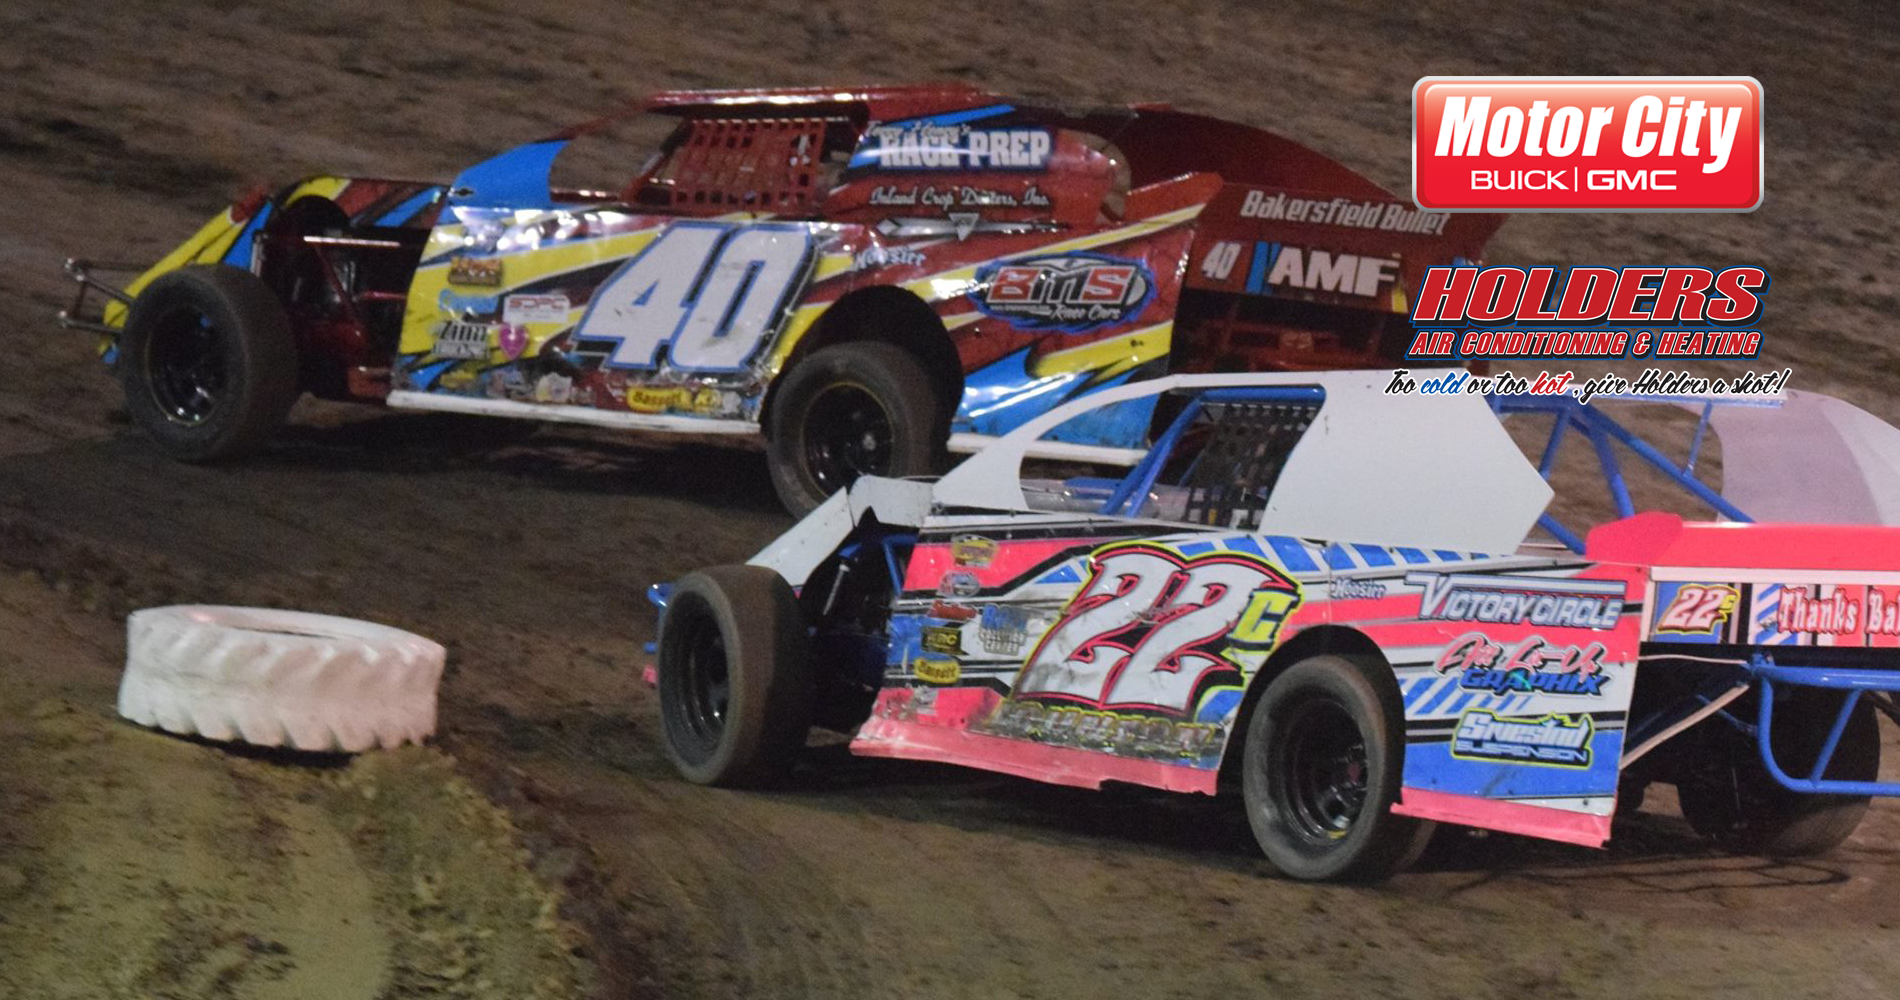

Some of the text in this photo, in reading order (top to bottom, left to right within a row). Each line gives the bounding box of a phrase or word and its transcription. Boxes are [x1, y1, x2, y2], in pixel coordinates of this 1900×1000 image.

[968, 130, 1051, 167] PREP
[1240, 190, 1451, 236] Bakersfield Bullet
[1201, 241, 1242, 280] 40
[1267, 246, 1401, 297] AMF
[573, 220, 814, 373] 40
[1779, 587, 1900, 635] Thanks Ba
